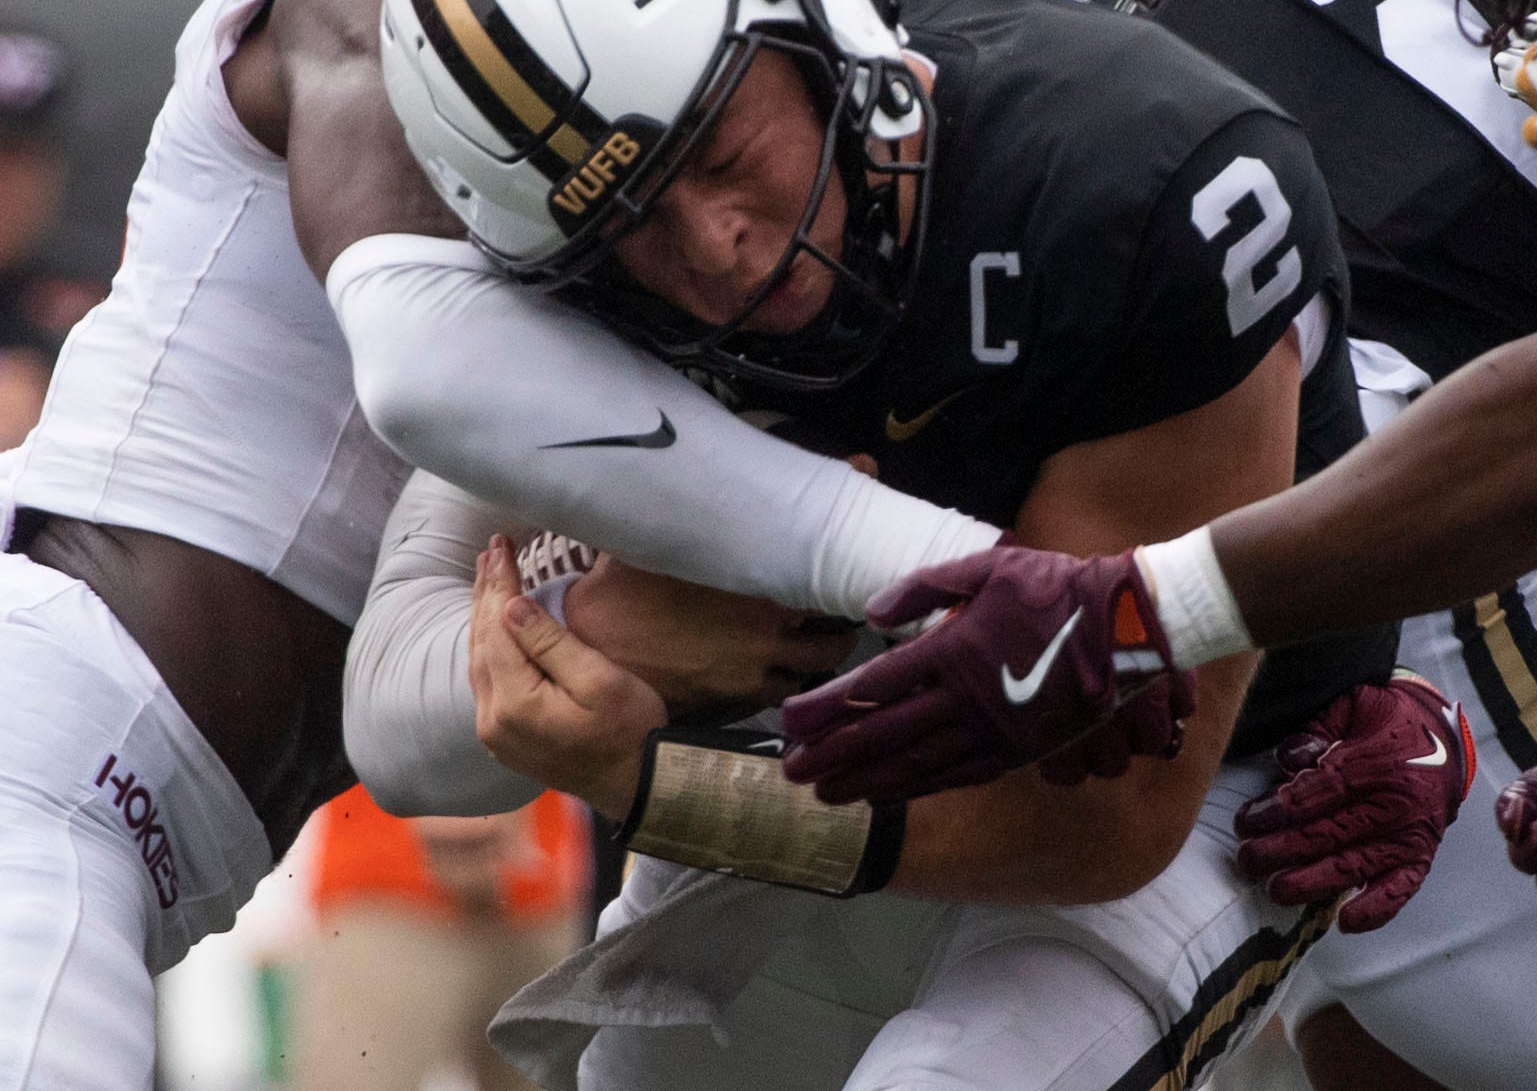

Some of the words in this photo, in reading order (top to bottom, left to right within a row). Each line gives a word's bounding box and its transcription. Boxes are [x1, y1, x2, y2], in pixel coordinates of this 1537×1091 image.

[553, 131, 640, 216] VUFB
[970, 251, 1021, 365] C
[1191, 155, 1302, 338] 2
[95, 753, 180, 910] HOKIES
